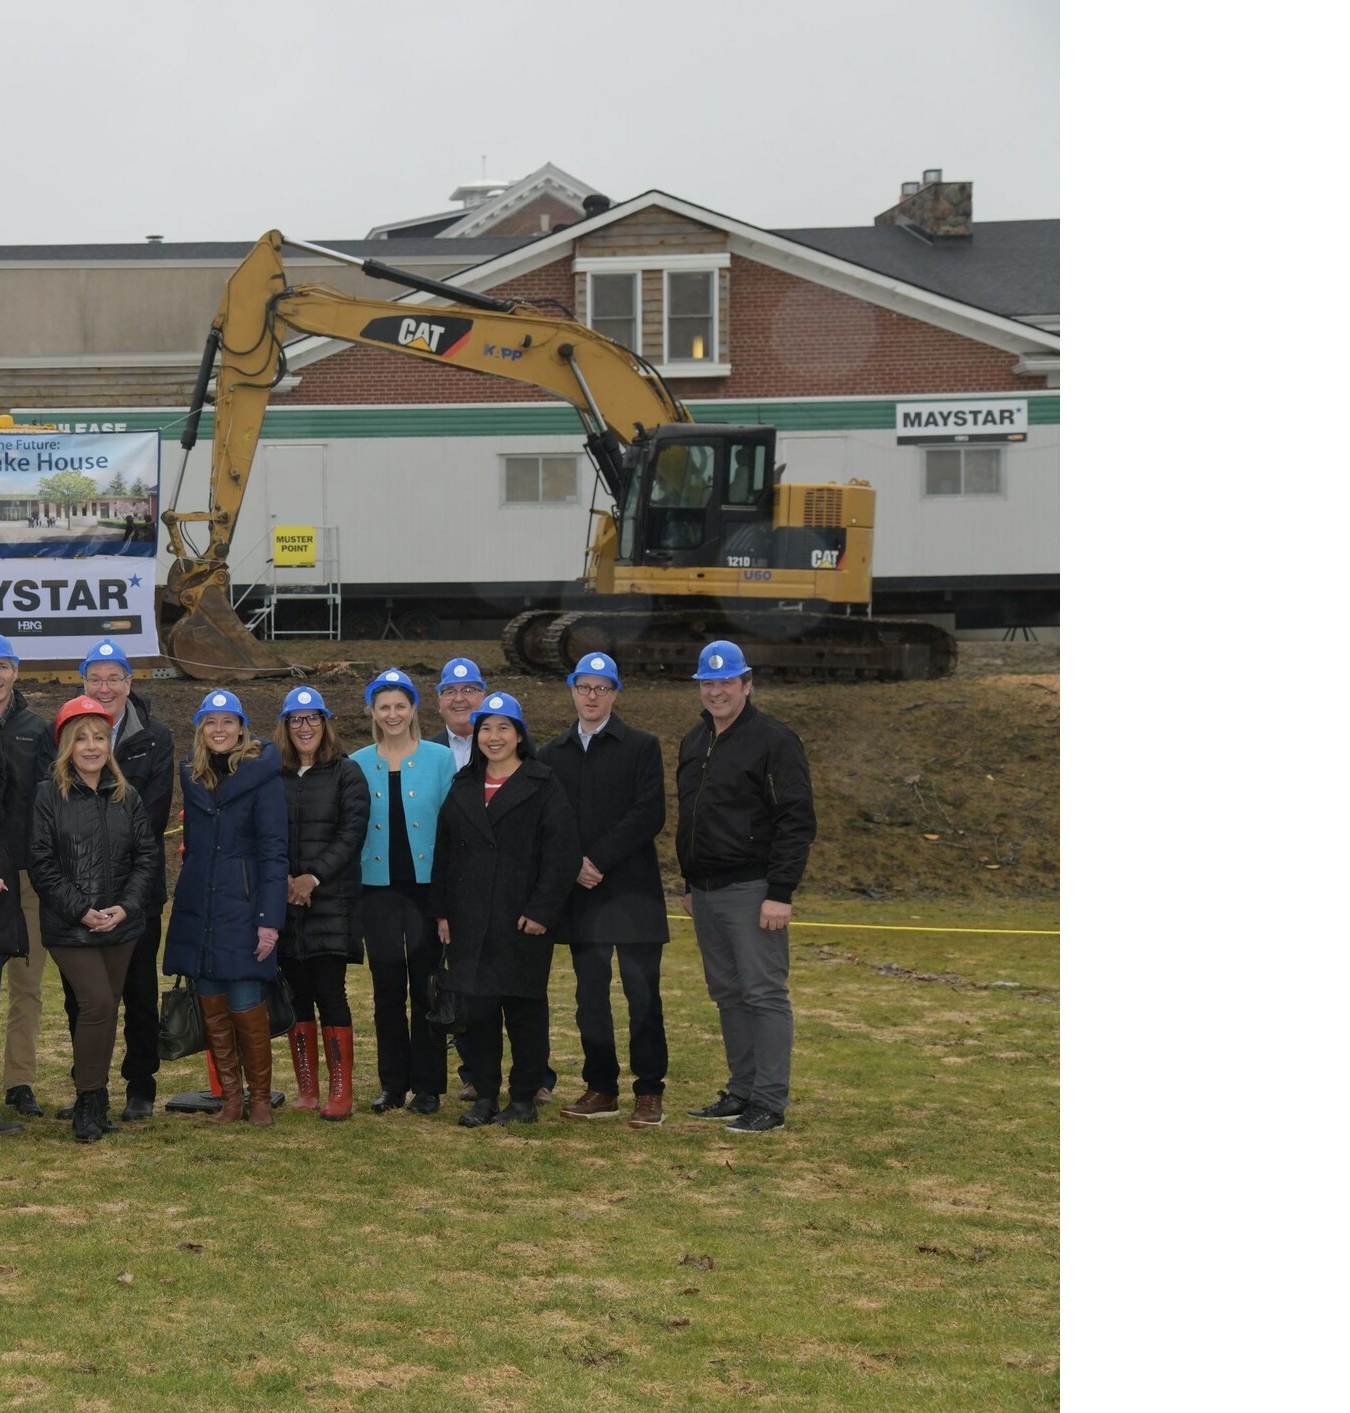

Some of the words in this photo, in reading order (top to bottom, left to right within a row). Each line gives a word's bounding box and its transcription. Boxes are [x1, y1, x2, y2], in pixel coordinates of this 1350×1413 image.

[397, 318, 445, 352] CAT
[902, 409, 1015, 428] MAYSTAR
[16, 439, 61, 450] Future:
[37, 452, 109, 471] House
[276, 535, 314, 544] MUSTER
[281, 544, 309, 552] POINT
[811, 549, 839, 568] CAT
[744, 570, 772, 581] U60
[17, 620, 43, 631] HBNG
